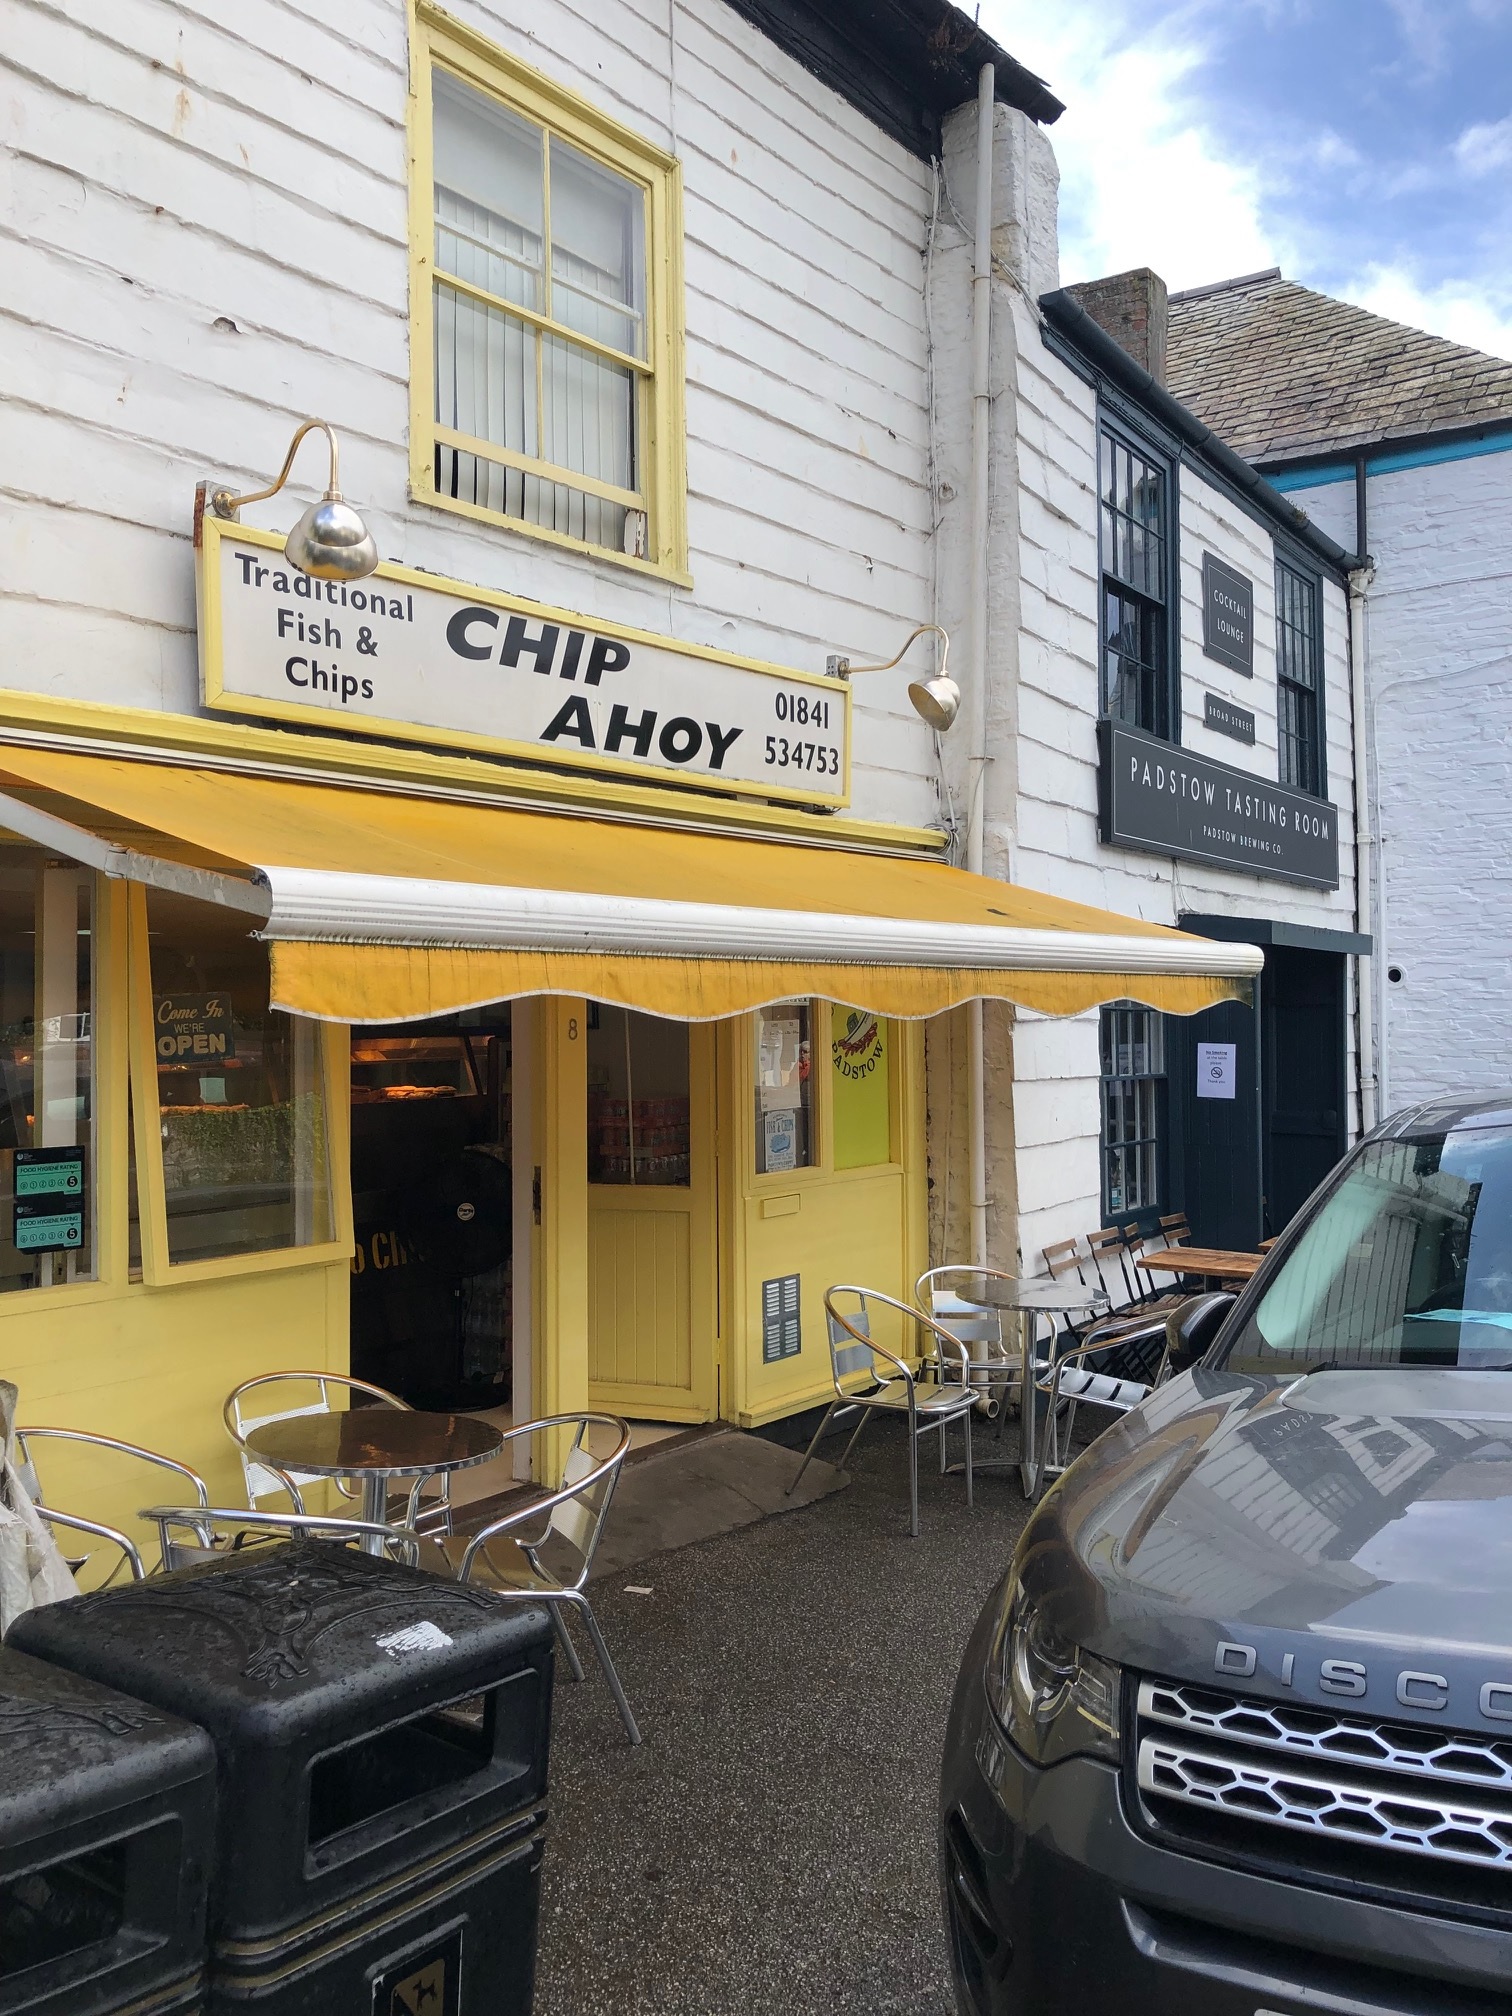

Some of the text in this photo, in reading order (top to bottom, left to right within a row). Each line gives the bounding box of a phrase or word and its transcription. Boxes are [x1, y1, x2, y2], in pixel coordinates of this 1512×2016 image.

[234, 552, 413, 622] Traditional
[1213, 589, 1247, 620] COCKTAIL
[277, 608, 379, 657] Fish &
[1217, 617, 1244, 644] LOUNGE
[446, 607, 631, 686] CHIP
[285, 656, 374, 704] Chips
[775, 692, 829, 729] 01841
[1209, 705, 1252, 733] BROAD STREET
[539, 695, 744, 770] AHOY
[764, 735, 839, 775] 534753
[1130, 756, 1329, 840] PADSTOW TASTING ROOM
[1203, 825, 1285, 856] PADSTOW BREWING CO.
[157, 999, 225, 1024] Come In
[173, 1022, 205, 1034] WE'RE
[568, 1018, 578, 1040] 8
[157, 1033, 226, 1057] OPEN
[20, 1163, 79, 1174] FOOD HYGIENE RATING
[20, 1215, 79, 1227] FOOD HYGIENE RATING
